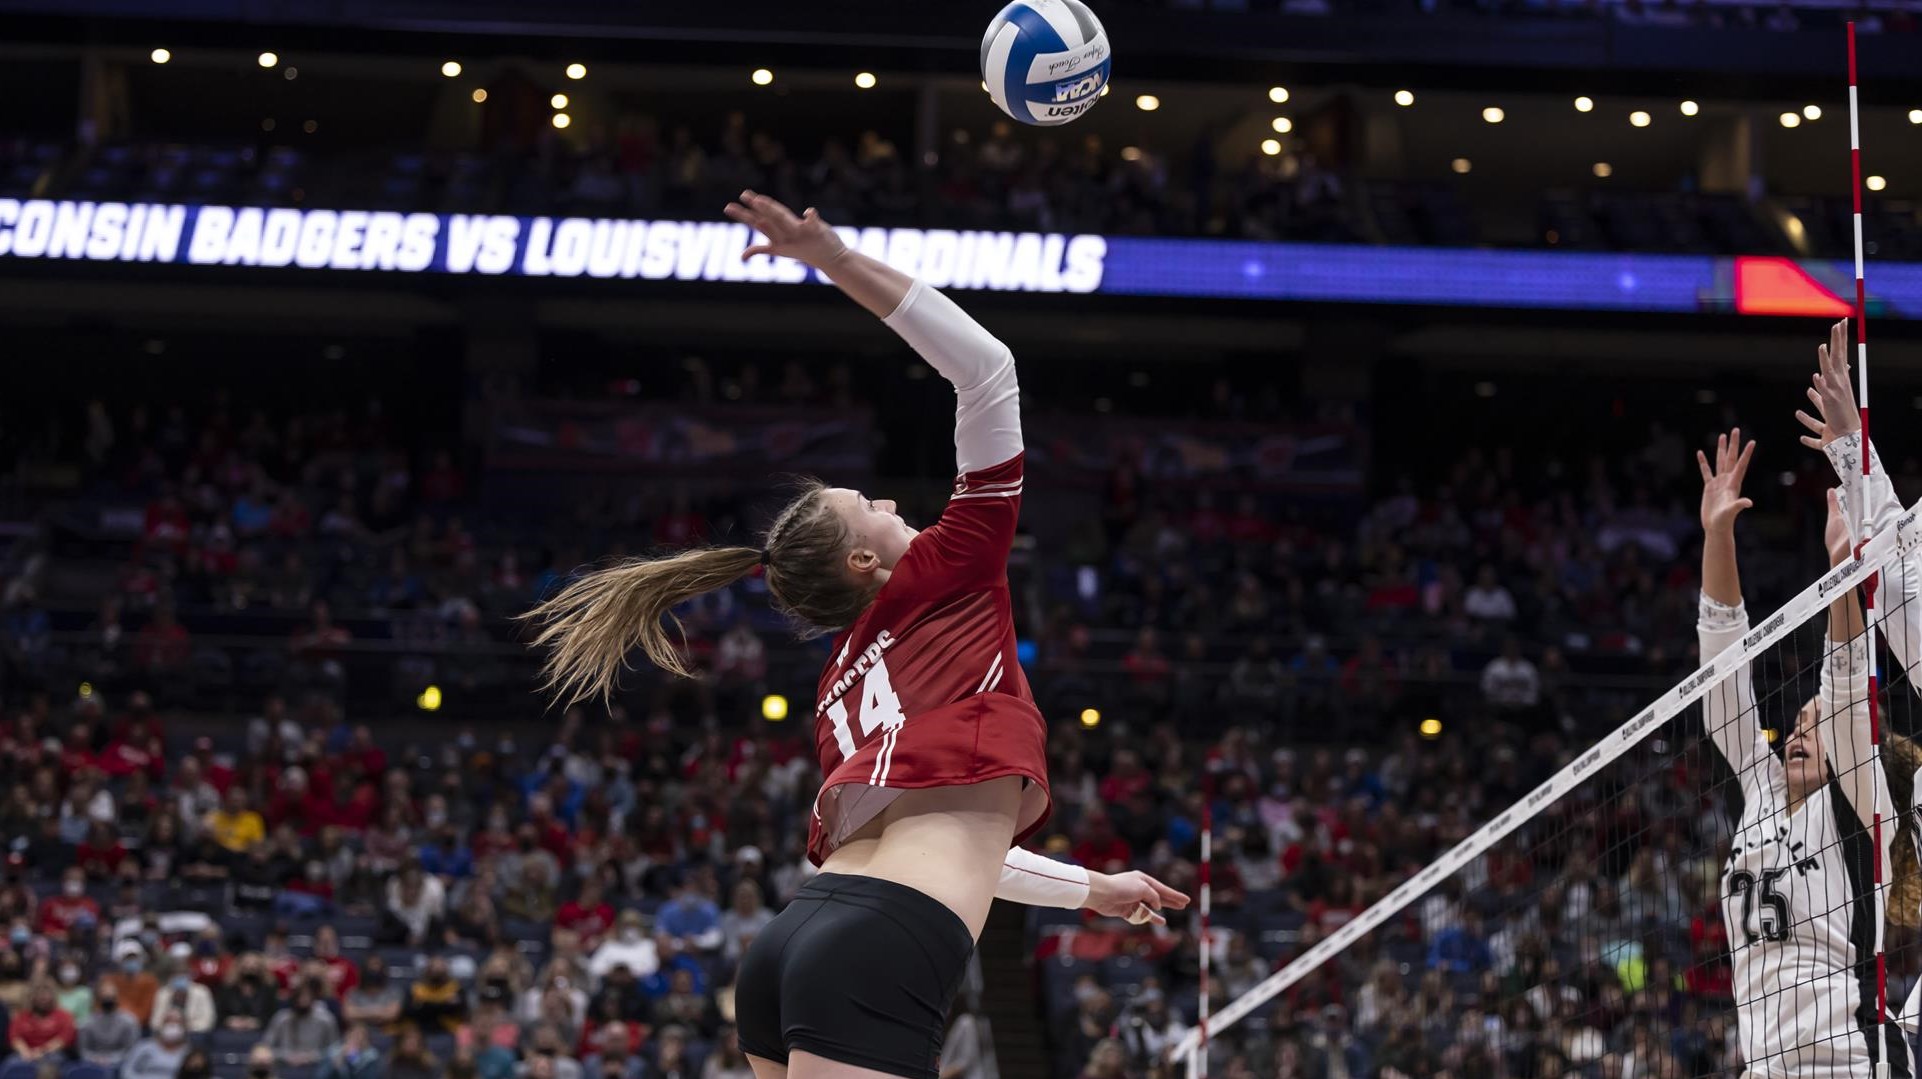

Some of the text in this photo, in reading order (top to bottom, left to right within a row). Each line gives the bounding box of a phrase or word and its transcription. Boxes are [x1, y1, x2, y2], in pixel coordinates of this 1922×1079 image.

[1049, 56, 1081, 75] Touch
[1055, 73, 1102, 102] NCAA
[188, 206, 440, 272] BADGERS
[445, 214, 520, 275] VS
[816, 227, 1107, 293] ARDINALS
[826, 655, 906, 762] 14
[1728, 868, 1792, 946] 25
